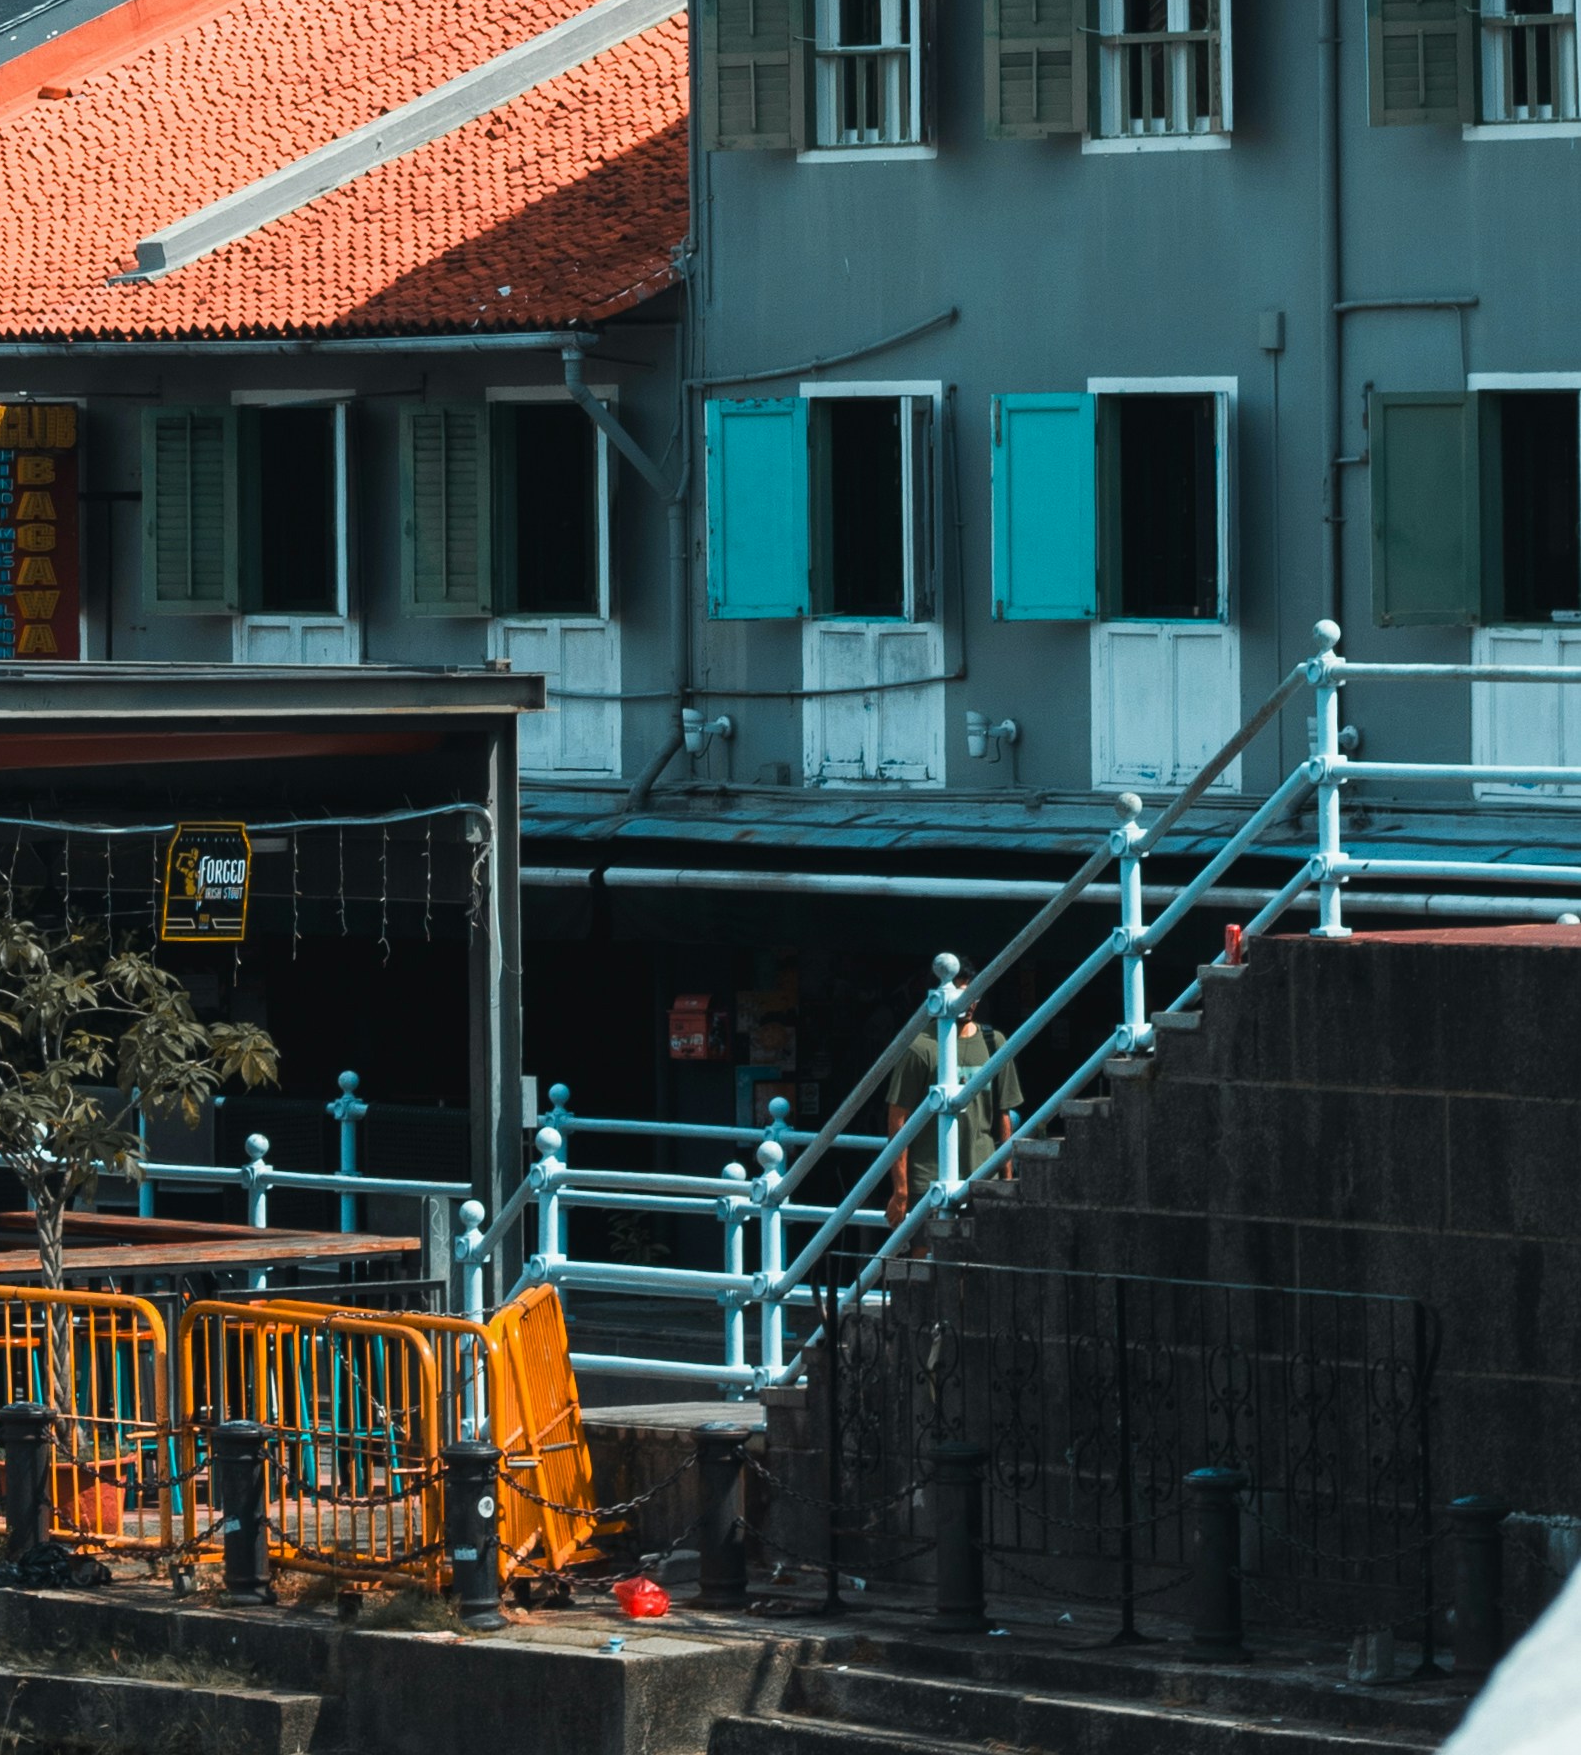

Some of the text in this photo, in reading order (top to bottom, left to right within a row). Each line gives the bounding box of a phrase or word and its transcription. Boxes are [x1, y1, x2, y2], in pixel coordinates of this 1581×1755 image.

[16, 455, 61, 653] BAGAWA
[200, 855, 246, 885] FORGED
[204, 886, 244, 899] IRISH STOUT
